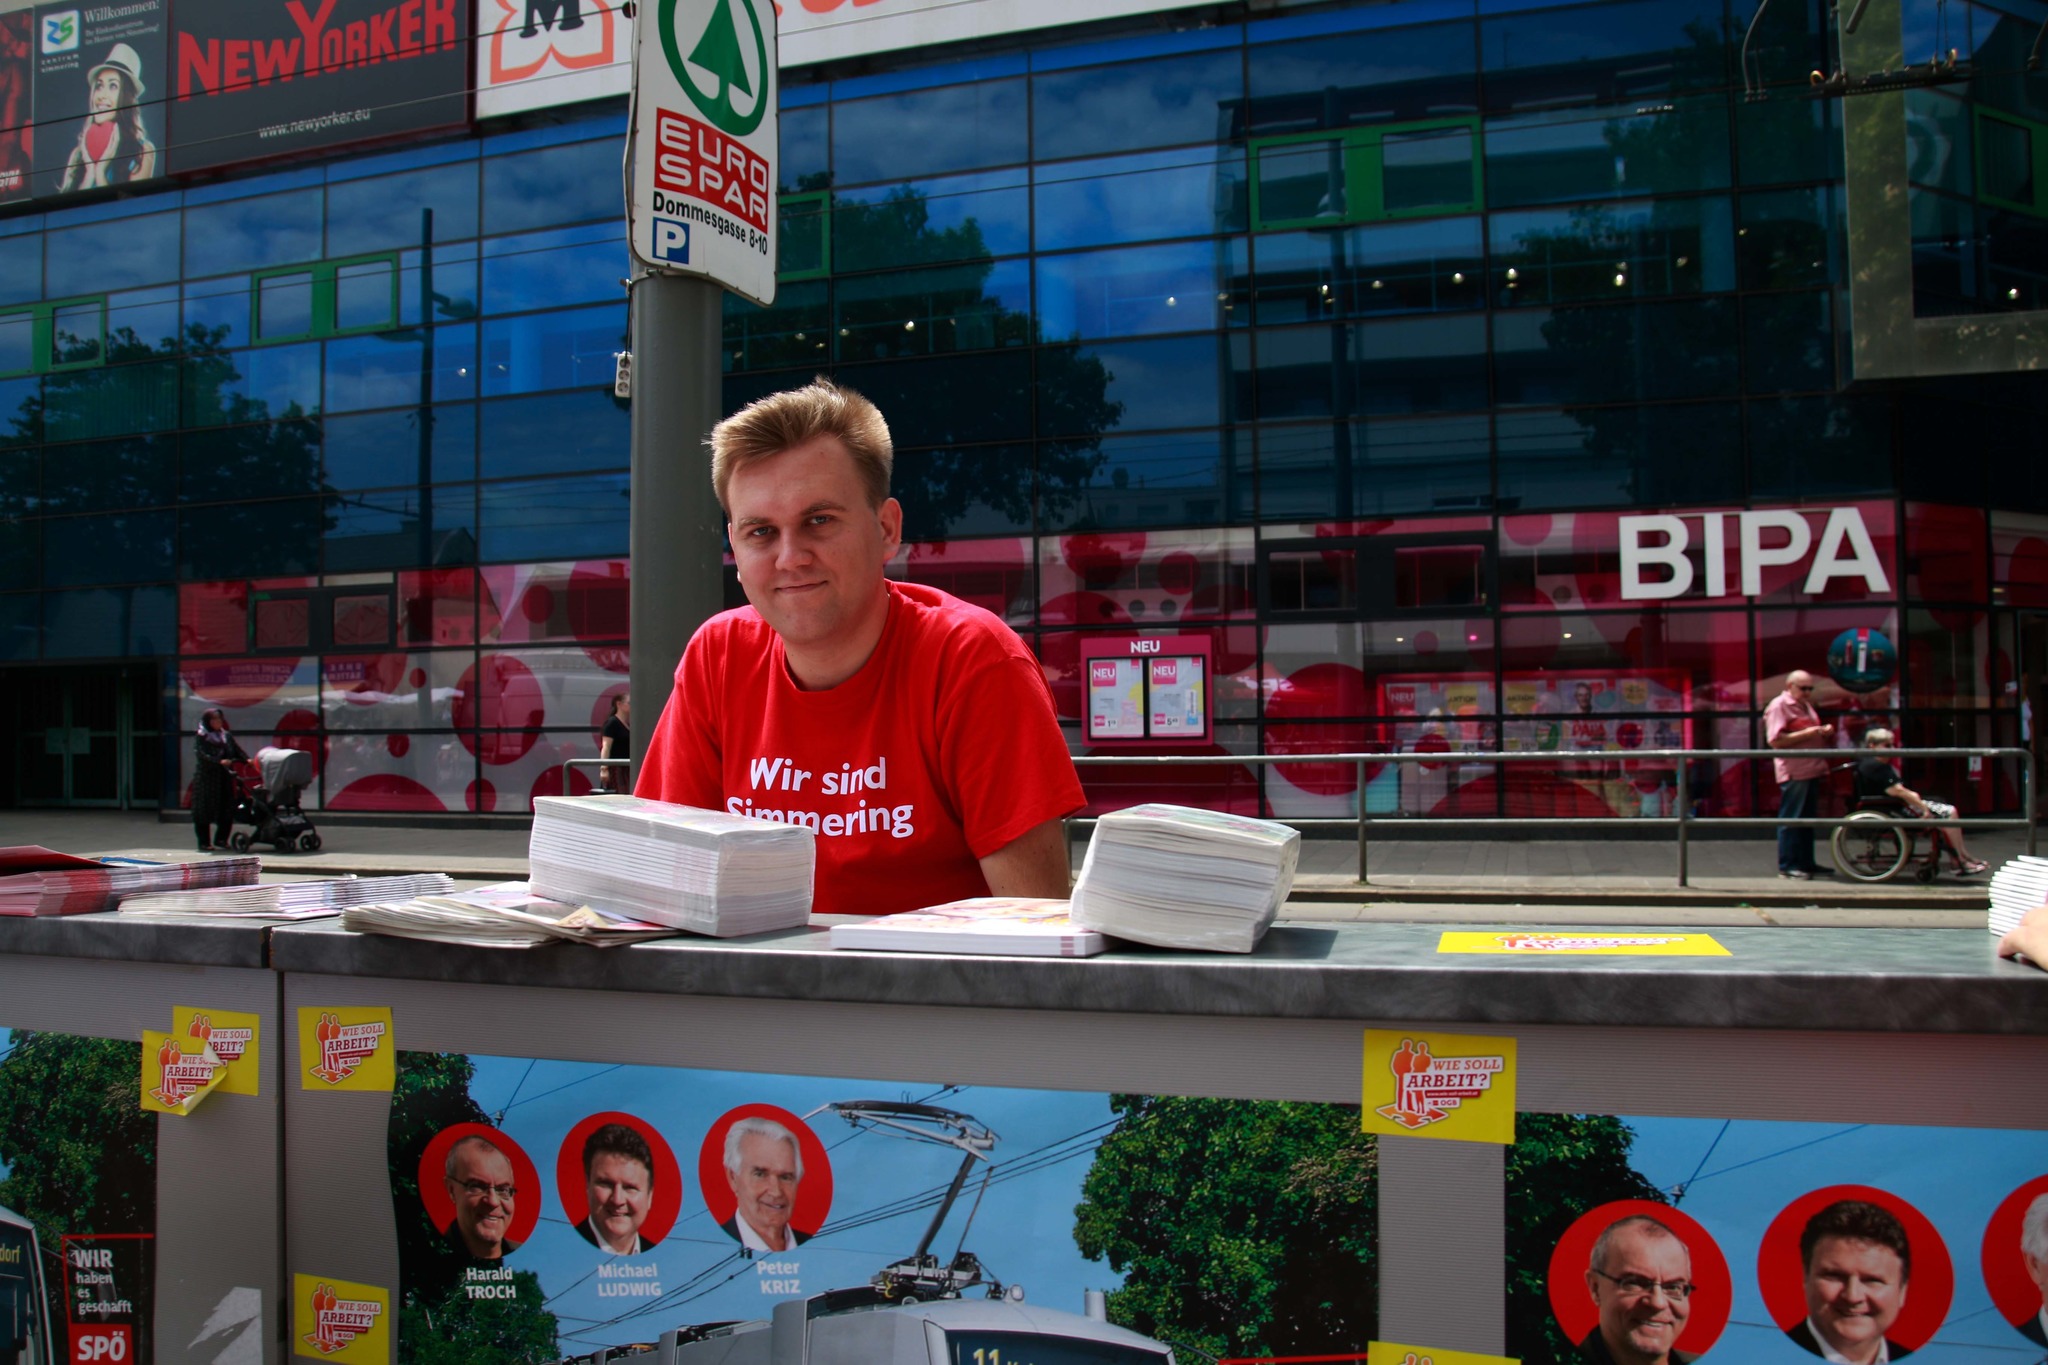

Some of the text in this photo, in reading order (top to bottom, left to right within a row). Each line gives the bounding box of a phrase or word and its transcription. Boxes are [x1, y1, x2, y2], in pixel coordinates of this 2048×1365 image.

[84, 0, 160, 23] Willkommen!
[258, 108, 371, 138] www.newyorker.eu
[660, 116, 768, 193] EURO
[659, 153, 767, 226] SPAR
[653, 191, 768, 255] Dommesgasse 8-10
[656, 220, 686, 258] P
[1619, 507, 1891, 600] BIPA
[1130, 640, 1160, 653] NEU
[1093, 668, 1115, 678] NEU
[1153, 665, 1176, 676] NEU
[750, 756, 886, 795] Wir sind
[212, 1030, 251, 1039] WIE SOLL
[342, 1024, 384, 1037] WIE SOLL
[208, 1041, 243, 1052] BEIT?
[327, 1036, 377, 1052] ARBEIT?
[181, 1056, 198, 1065] WIE
[1433, 1059, 1500, 1071] WIE SOLL
[166, 1066, 212, 1078] ARBEIT?
[1406, 1073, 1488, 1088] ARBEIT?
[75, 1249, 114, 1268] WIR
[466, 1266, 513, 1281] Harald
[598, 1263, 658, 1278] Michael
[757, 1260, 799, 1275] Peter
[75, 1272, 113, 1284] haben
[77, 1288, 90, 1298] es
[465, 1285, 516, 1299] TROCH
[598, 1282, 662, 1297] LUDWIG
[760, 1280, 801, 1294] KRIZ
[78, 1300, 132, 1315] geschafft
[338, 1302, 380, 1313] WIE SOLL
[321, 1312, 372, 1325] ARBEIT?
[77, 1331, 126, 1361] SPÖ
